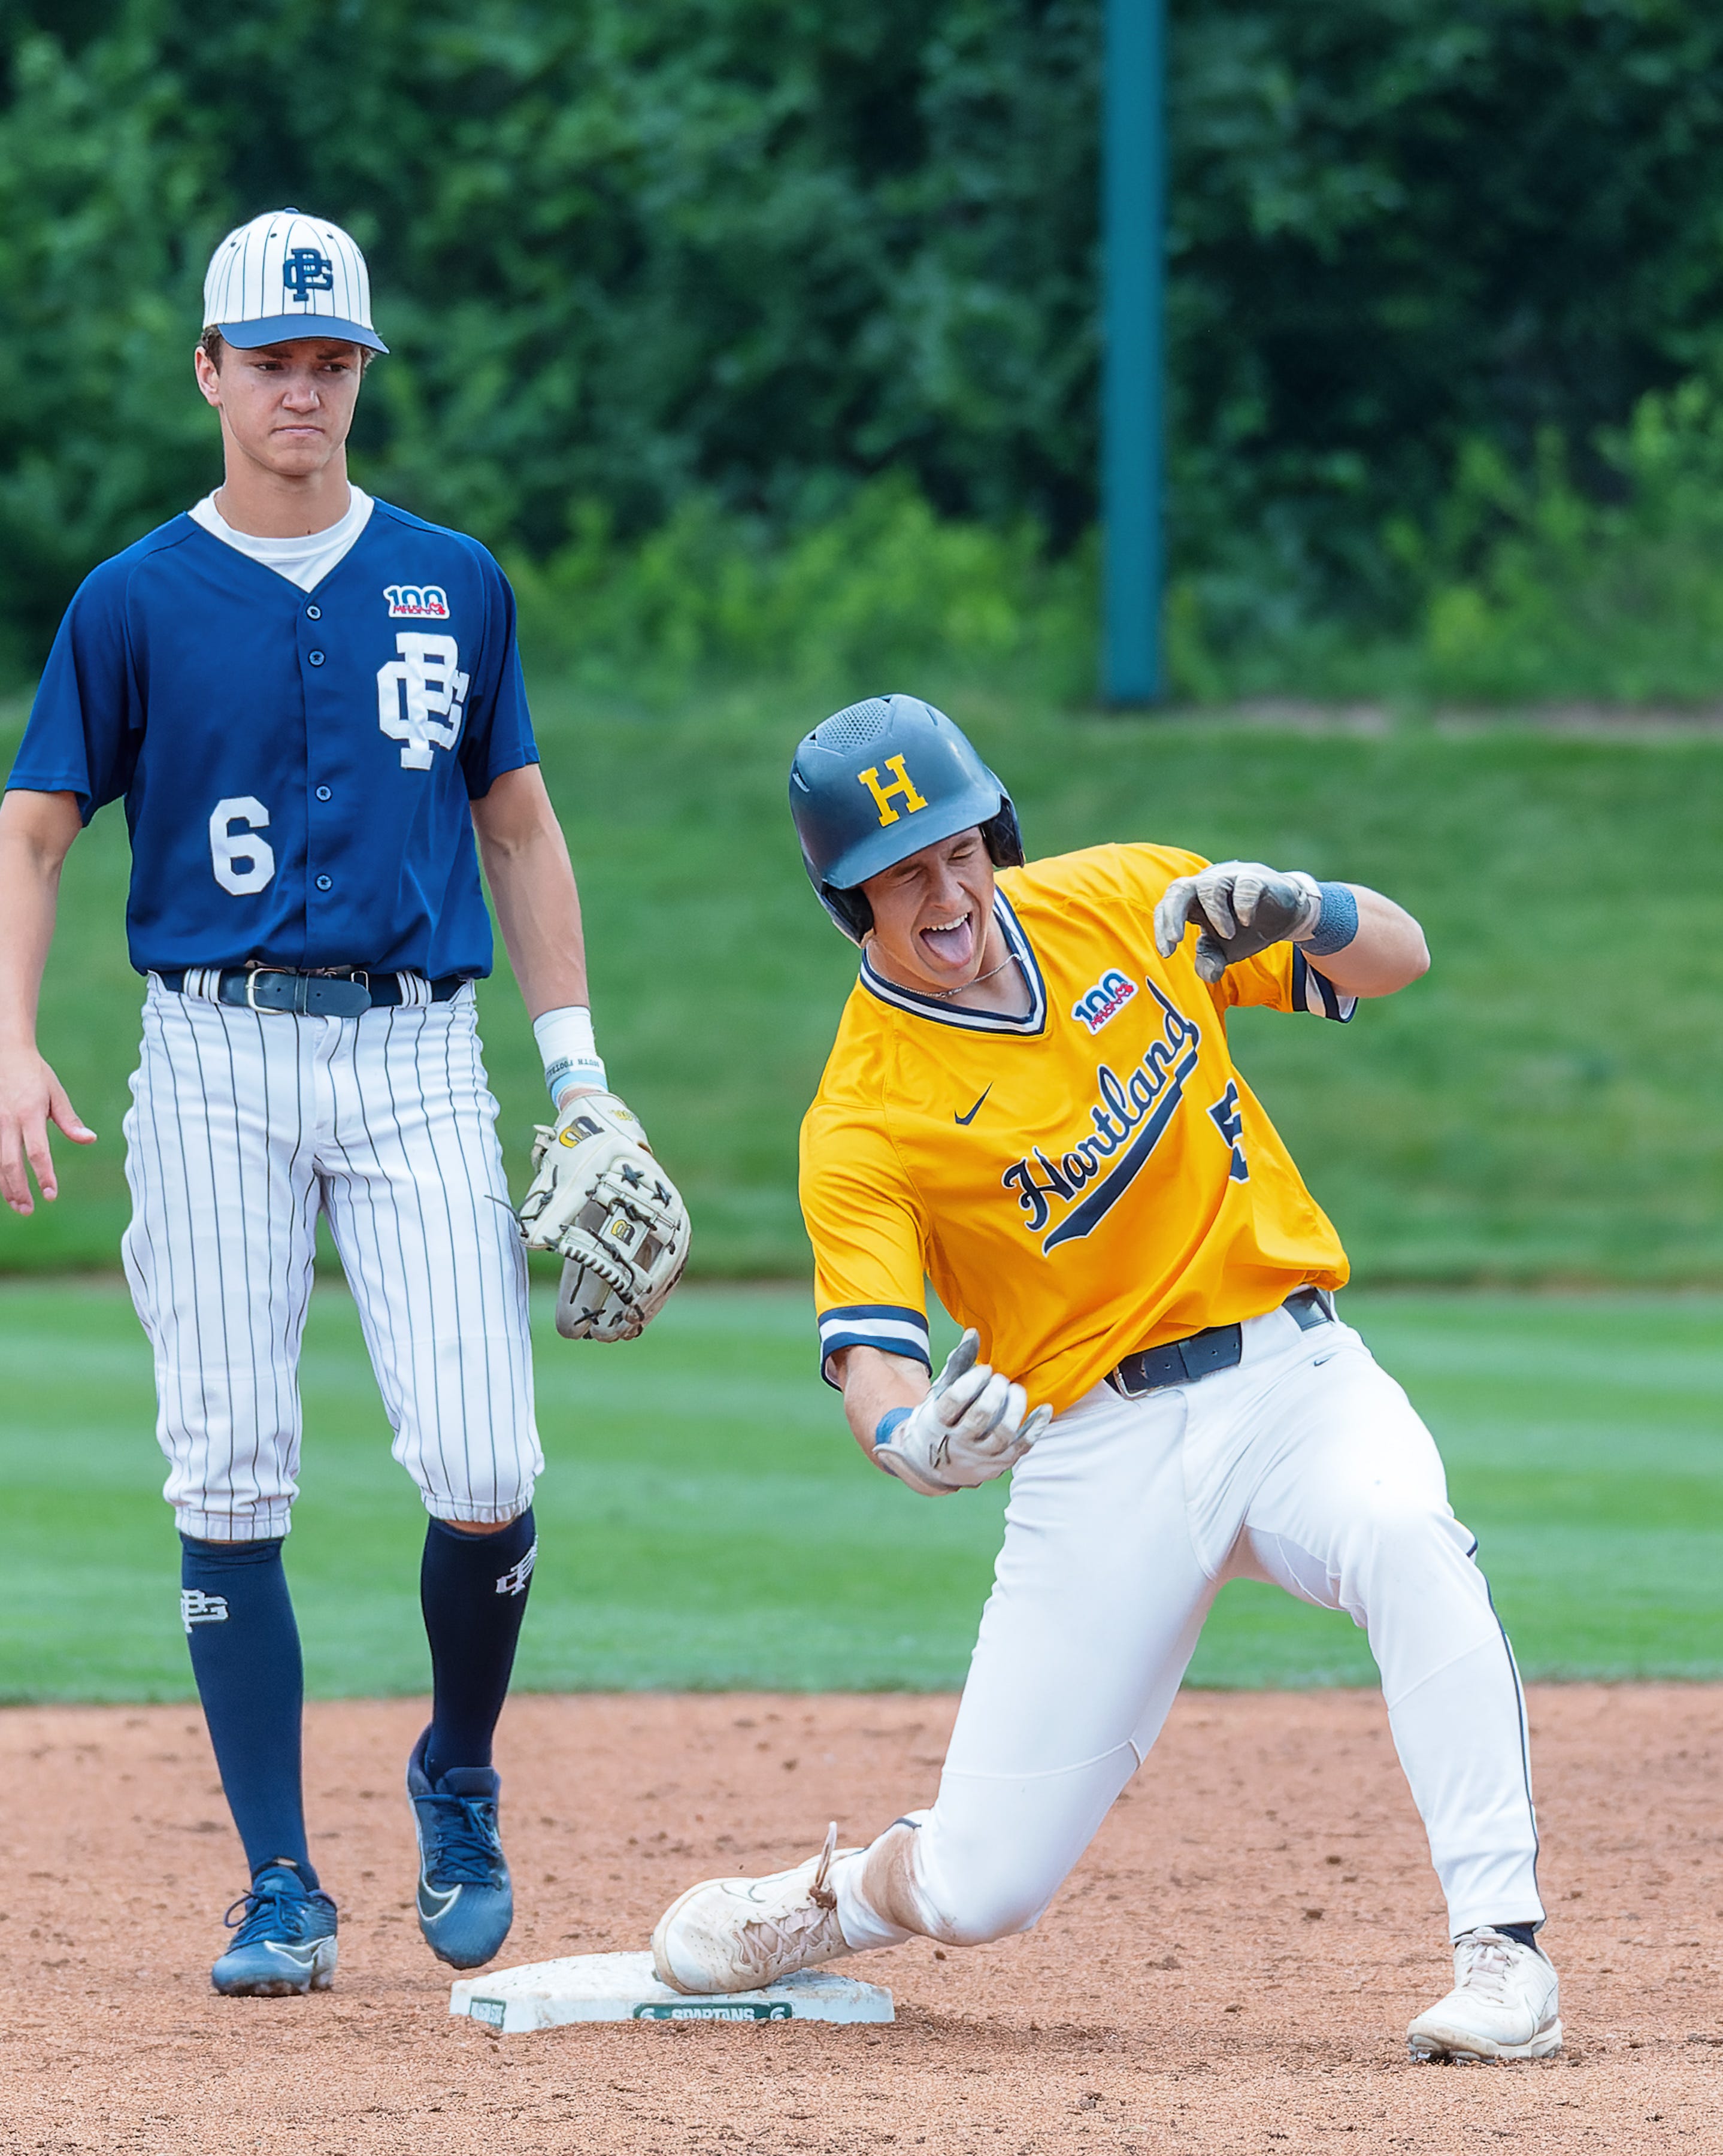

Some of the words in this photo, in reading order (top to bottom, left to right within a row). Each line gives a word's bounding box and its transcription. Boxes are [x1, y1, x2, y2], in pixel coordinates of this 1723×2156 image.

[858, 753, 928, 827] H
[210, 796, 275, 896] 6
[1002, 976, 1201, 1232] Hartland
[1207, 1078, 1250, 1184] 5
[671, 2008, 755, 2021] SPARTANS
